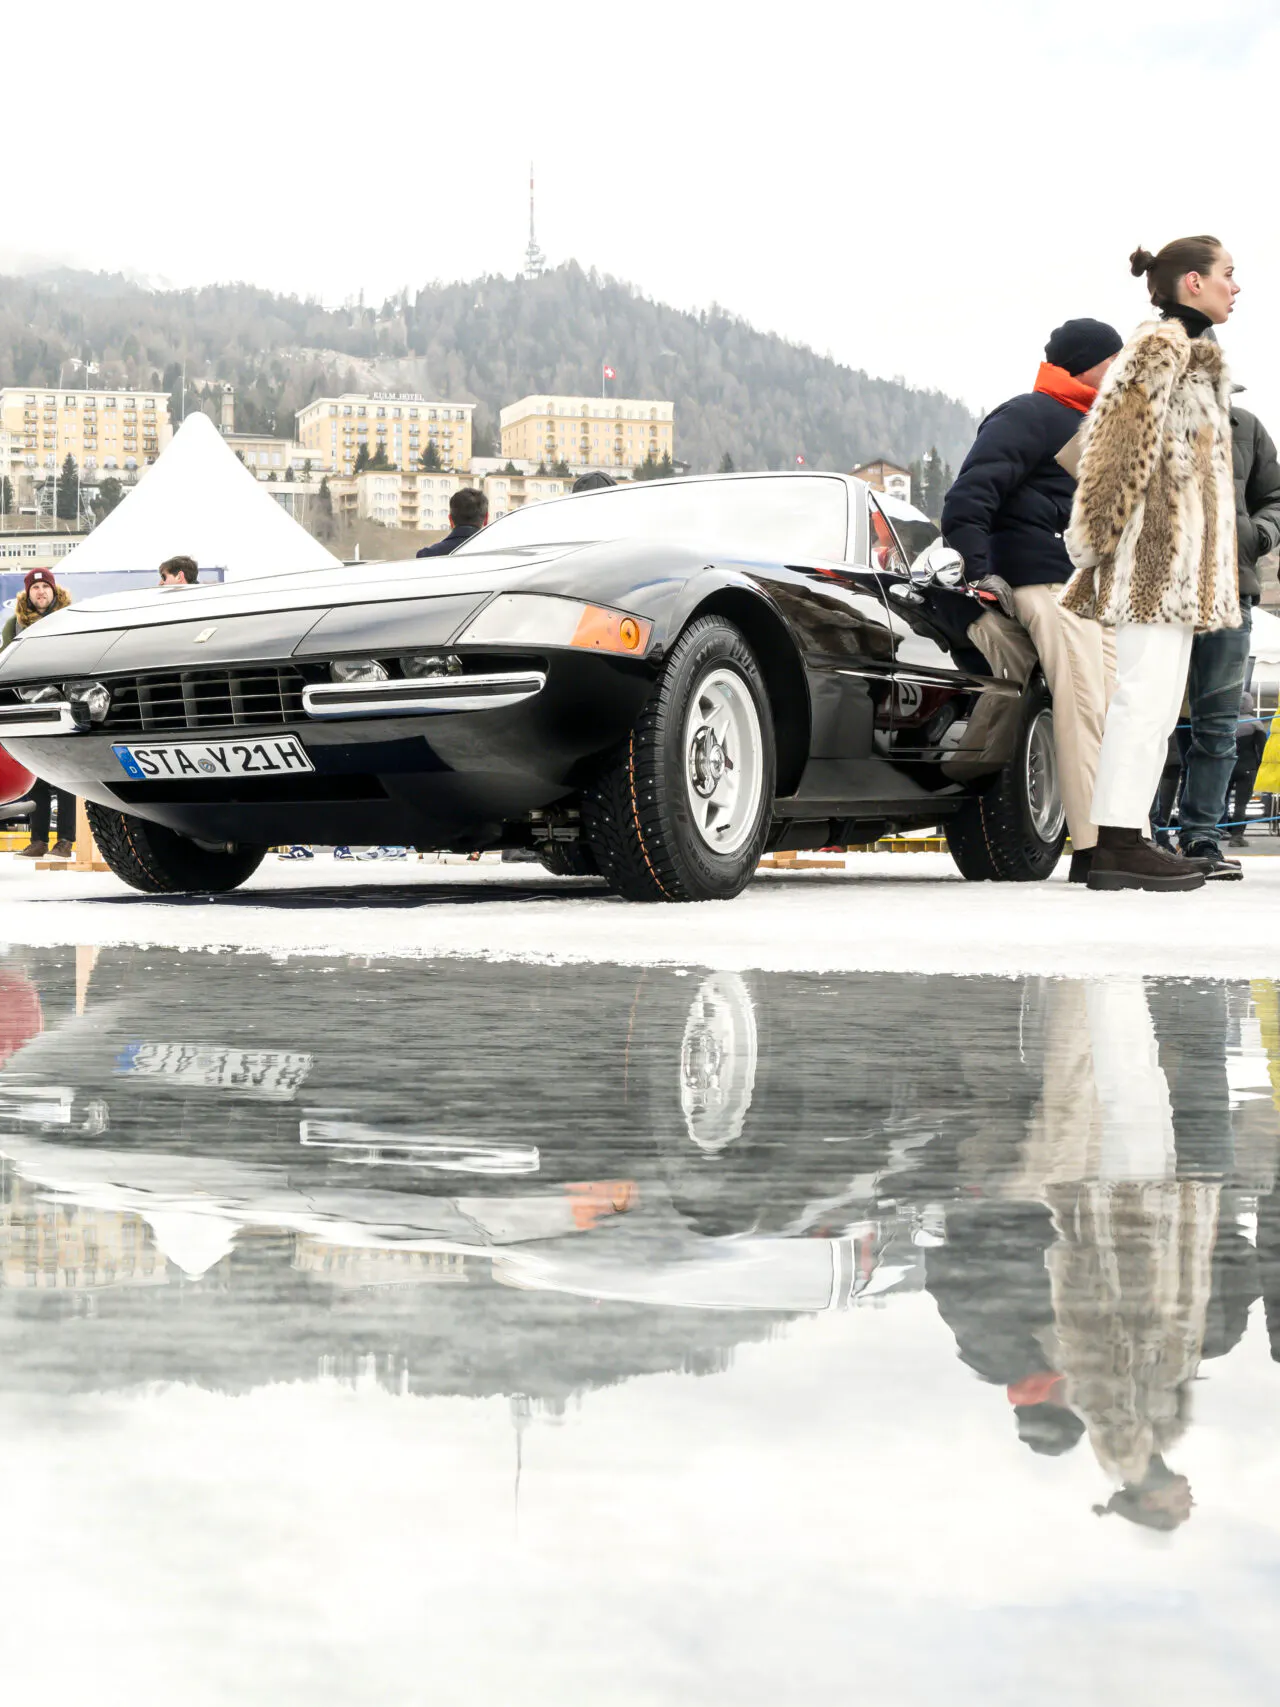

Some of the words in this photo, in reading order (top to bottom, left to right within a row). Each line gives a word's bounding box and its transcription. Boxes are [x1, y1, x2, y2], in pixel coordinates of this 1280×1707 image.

[129, 765, 138, 774] D
[134, 749, 200, 775] STA
[205, 747, 231, 773] Y
